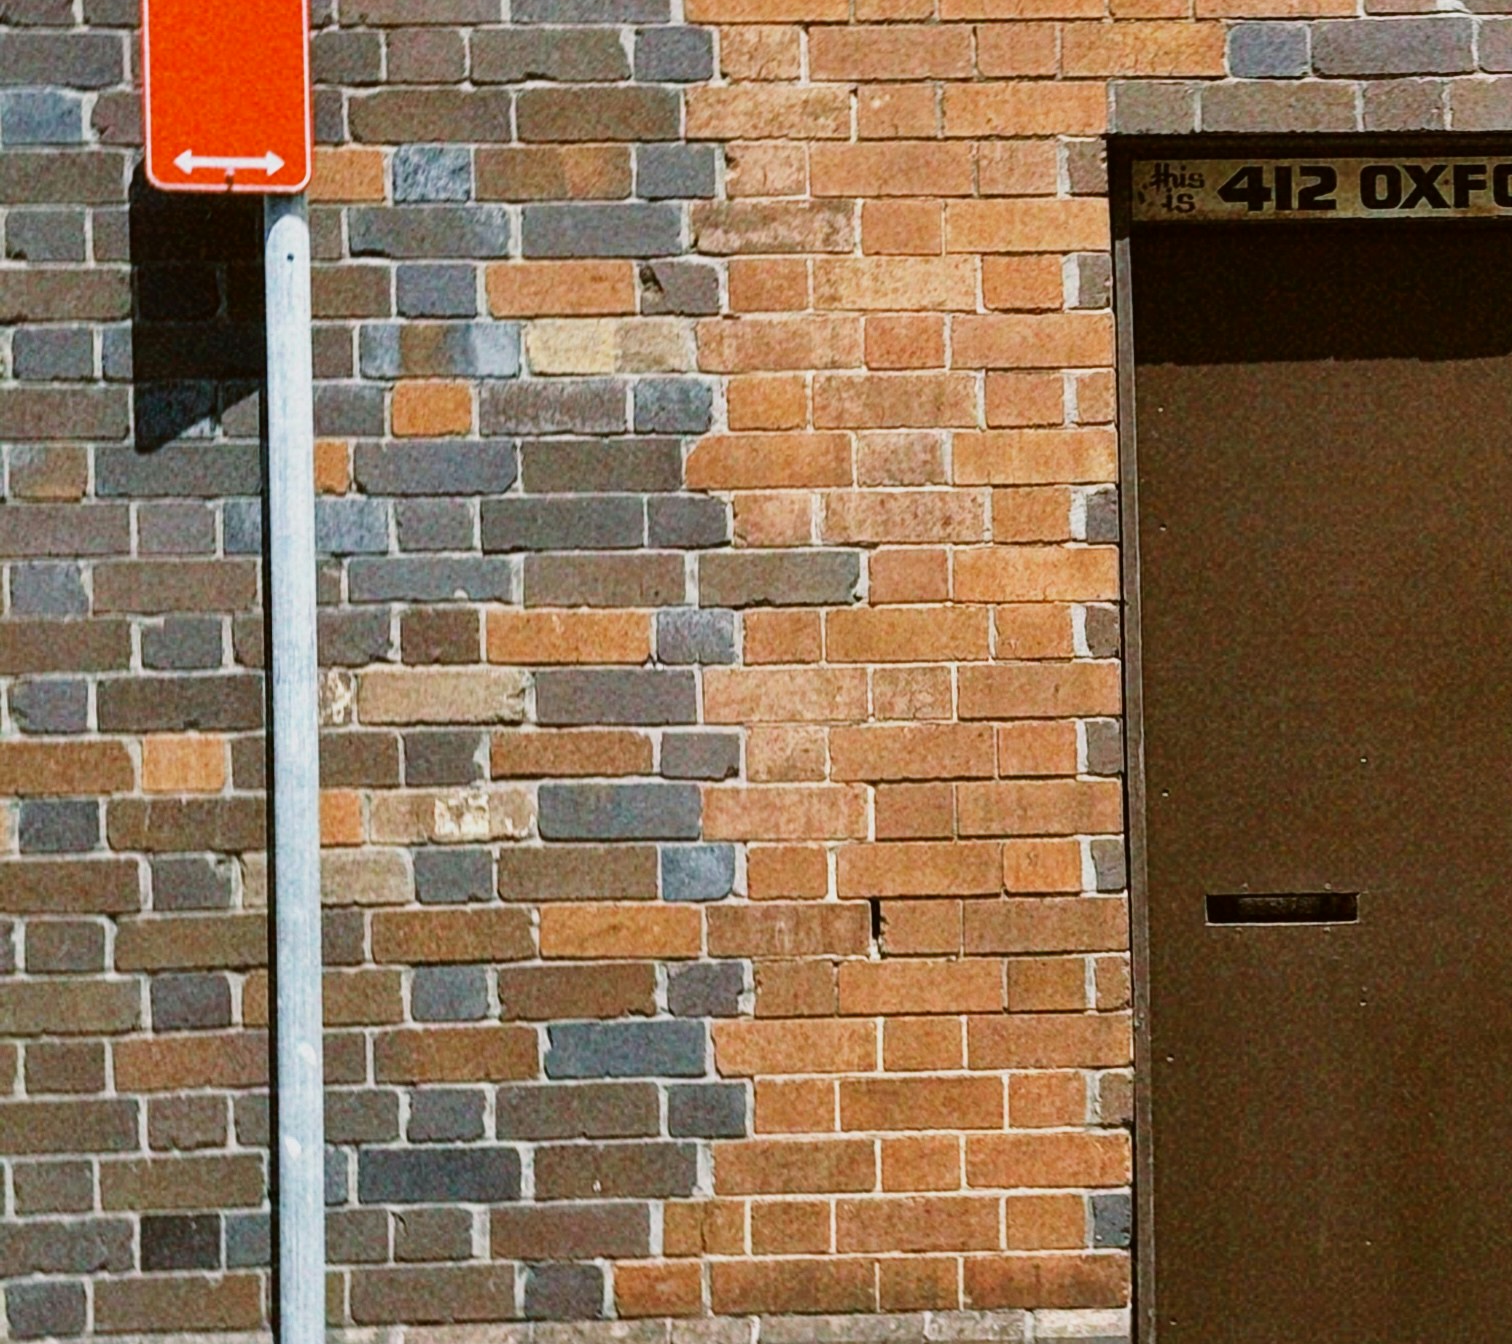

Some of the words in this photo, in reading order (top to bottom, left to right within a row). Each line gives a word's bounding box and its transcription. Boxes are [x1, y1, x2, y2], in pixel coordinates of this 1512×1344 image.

[1150, 162, 1204, 191] this
[1217, 165, 1337, 211] 412
[1162, 188, 1196, 213] is
